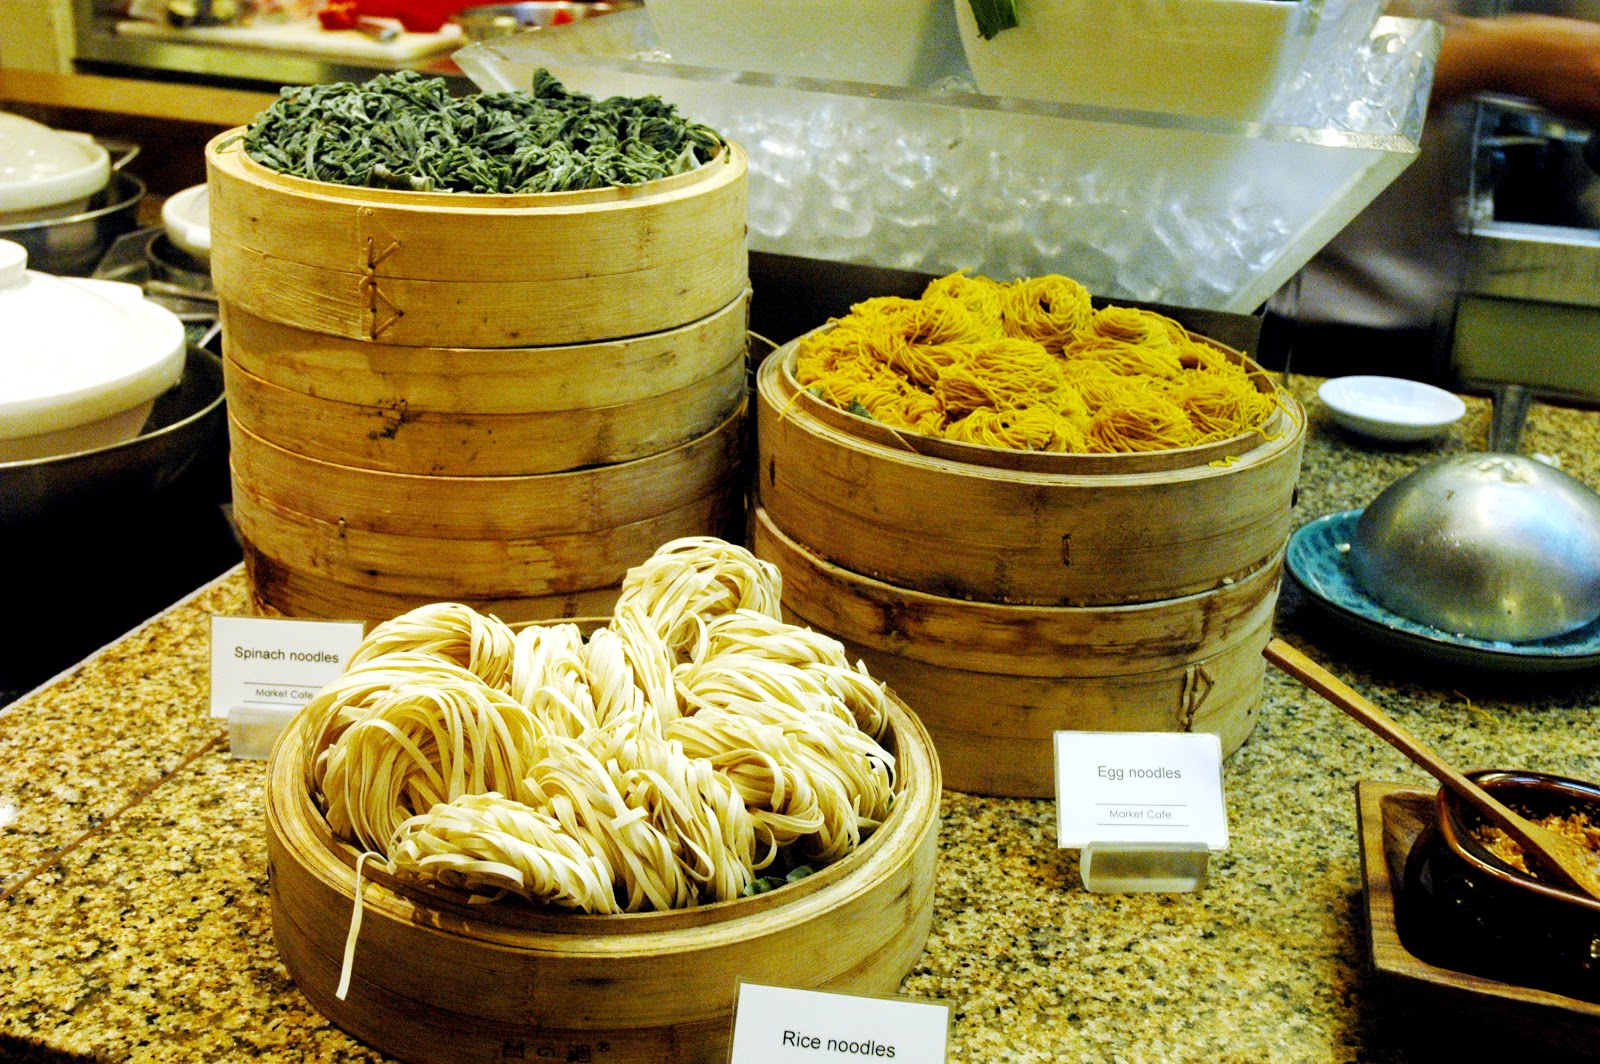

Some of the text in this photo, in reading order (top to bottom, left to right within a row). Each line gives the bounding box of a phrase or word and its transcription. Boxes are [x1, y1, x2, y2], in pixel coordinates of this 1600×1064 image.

[235, 646, 339, 663] Spinach noodles
[255, 688, 314, 700] Market Cafe
[1098, 765, 1181, 780] Egg noodles
[1109, 809, 1172, 819] Market Cafe
[782, 1030, 896, 1058] Rice noodles
